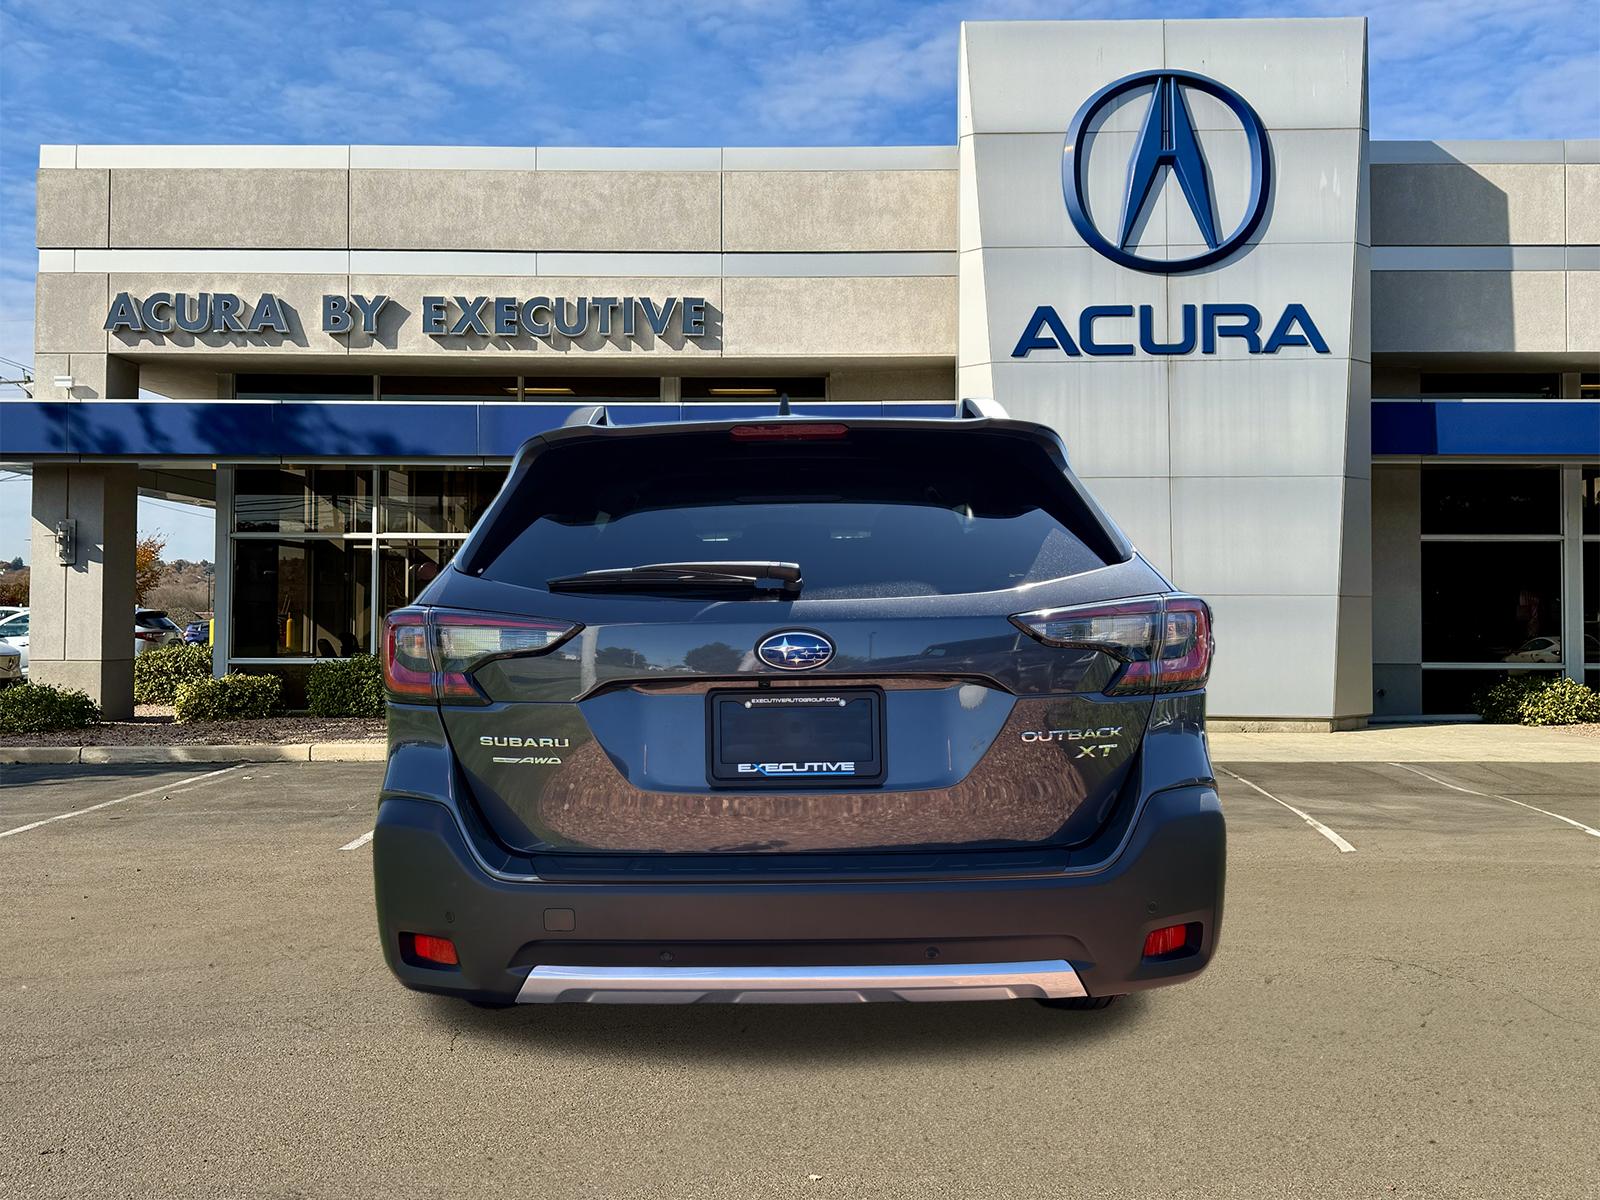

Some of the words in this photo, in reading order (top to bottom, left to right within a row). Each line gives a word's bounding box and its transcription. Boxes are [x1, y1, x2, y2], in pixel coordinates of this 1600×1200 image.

[104, 292, 290, 334] ACURA
[322, 294, 390, 335] BY
[422, 296, 707, 338] EXECUTIVE
[1011, 303, 1331, 357] ACURA
[479, 736, 570, 748] SUBARU
[1021, 726, 1123, 742] OUTBACK
[1074, 743, 1118, 759] XT
[518, 756, 562, 764] AWD
[737, 762, 855, 774] EXECUTIVE
